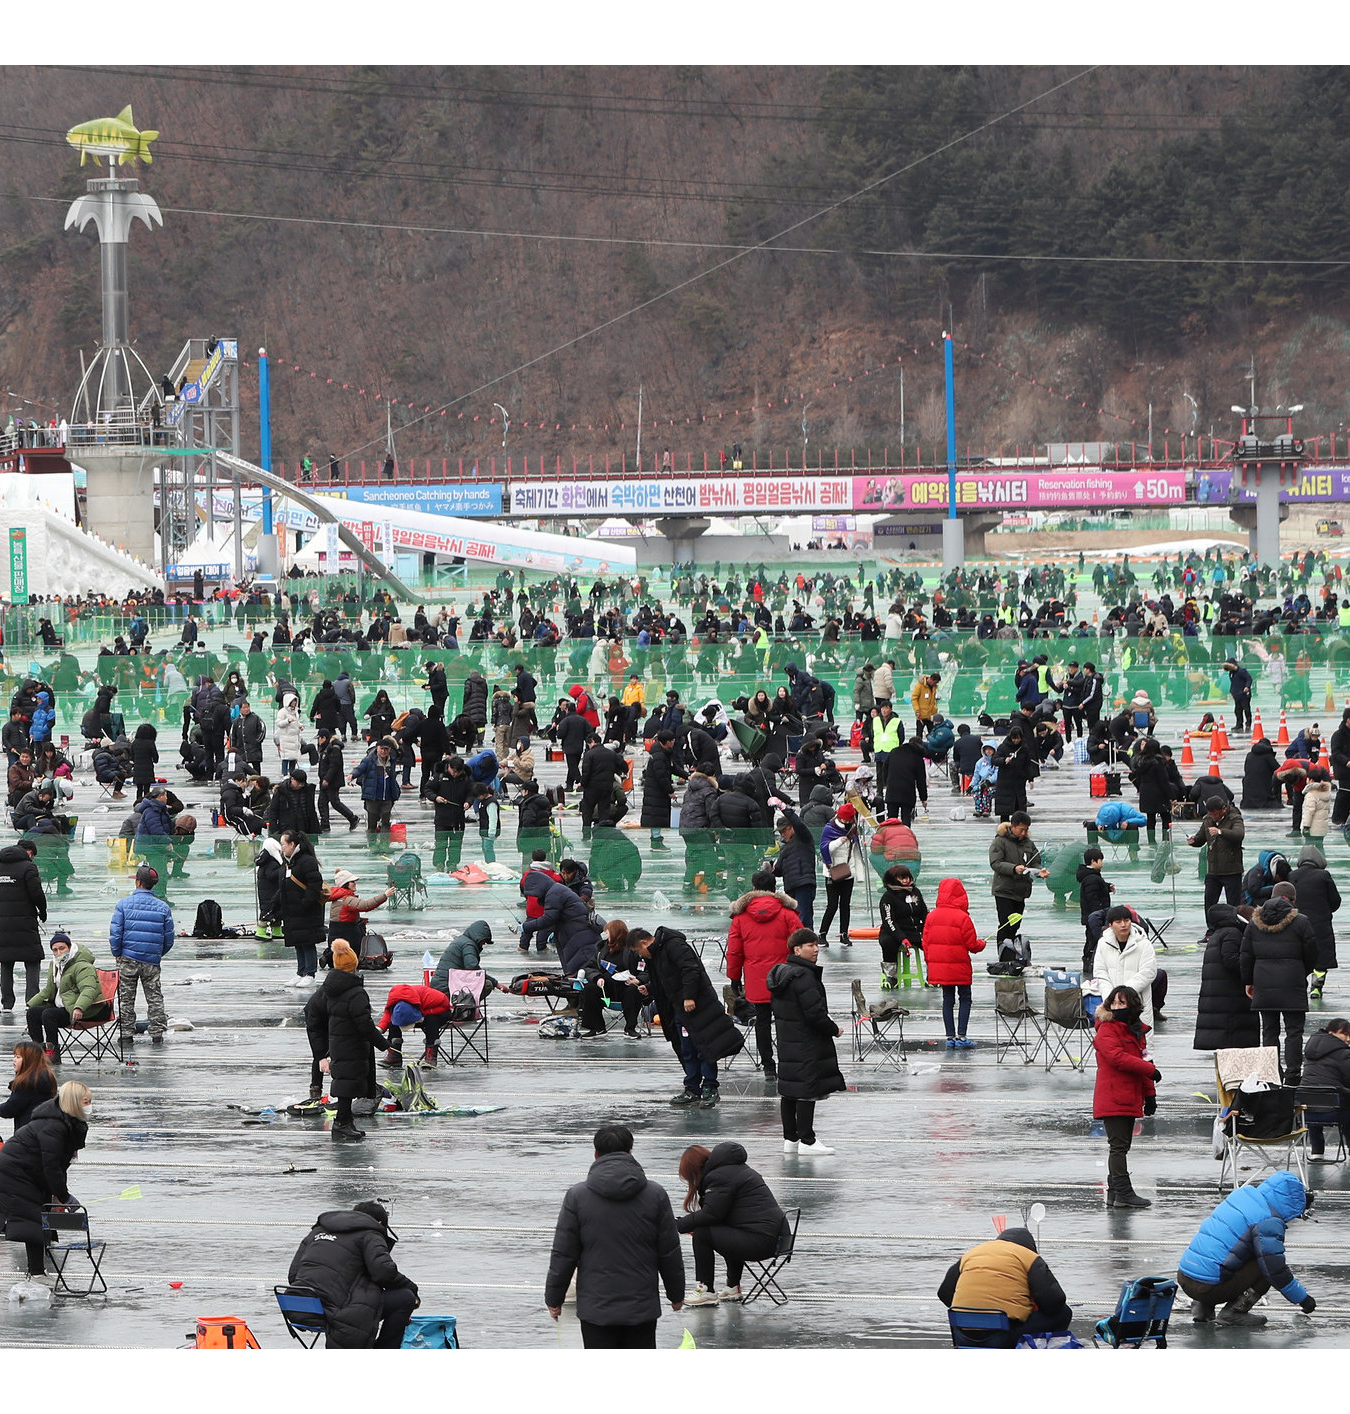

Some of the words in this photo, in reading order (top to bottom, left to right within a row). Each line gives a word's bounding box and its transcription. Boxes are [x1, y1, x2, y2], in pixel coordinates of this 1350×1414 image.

[1038, 479, 1085, 490] Reservation
[1086, 478, 1113, 490] fishing
[1146, 479, 1183, 499] 50m
[363, 490, 415, 501] Sancheoneo
[415, 490, 452, 502] Catching
[453, 489, 463, 501] by
[464, 488, 490, 499] hands
[515, 488, 559, 509] 축제기간
[561, 485, 608, 509] 화천에서
[611, 484, 661, 508] 숙박하면
[664, 486, 696, 507] 산천어
[700, 483, 739, 507] 밤낚시,
[743, 482, 816, 506] 평일얼음낚시
[820, 482, 848, 505] 공짜!
[466, 541, 496, 558] 공짜!
[205, 566, 220, 576] 대여
